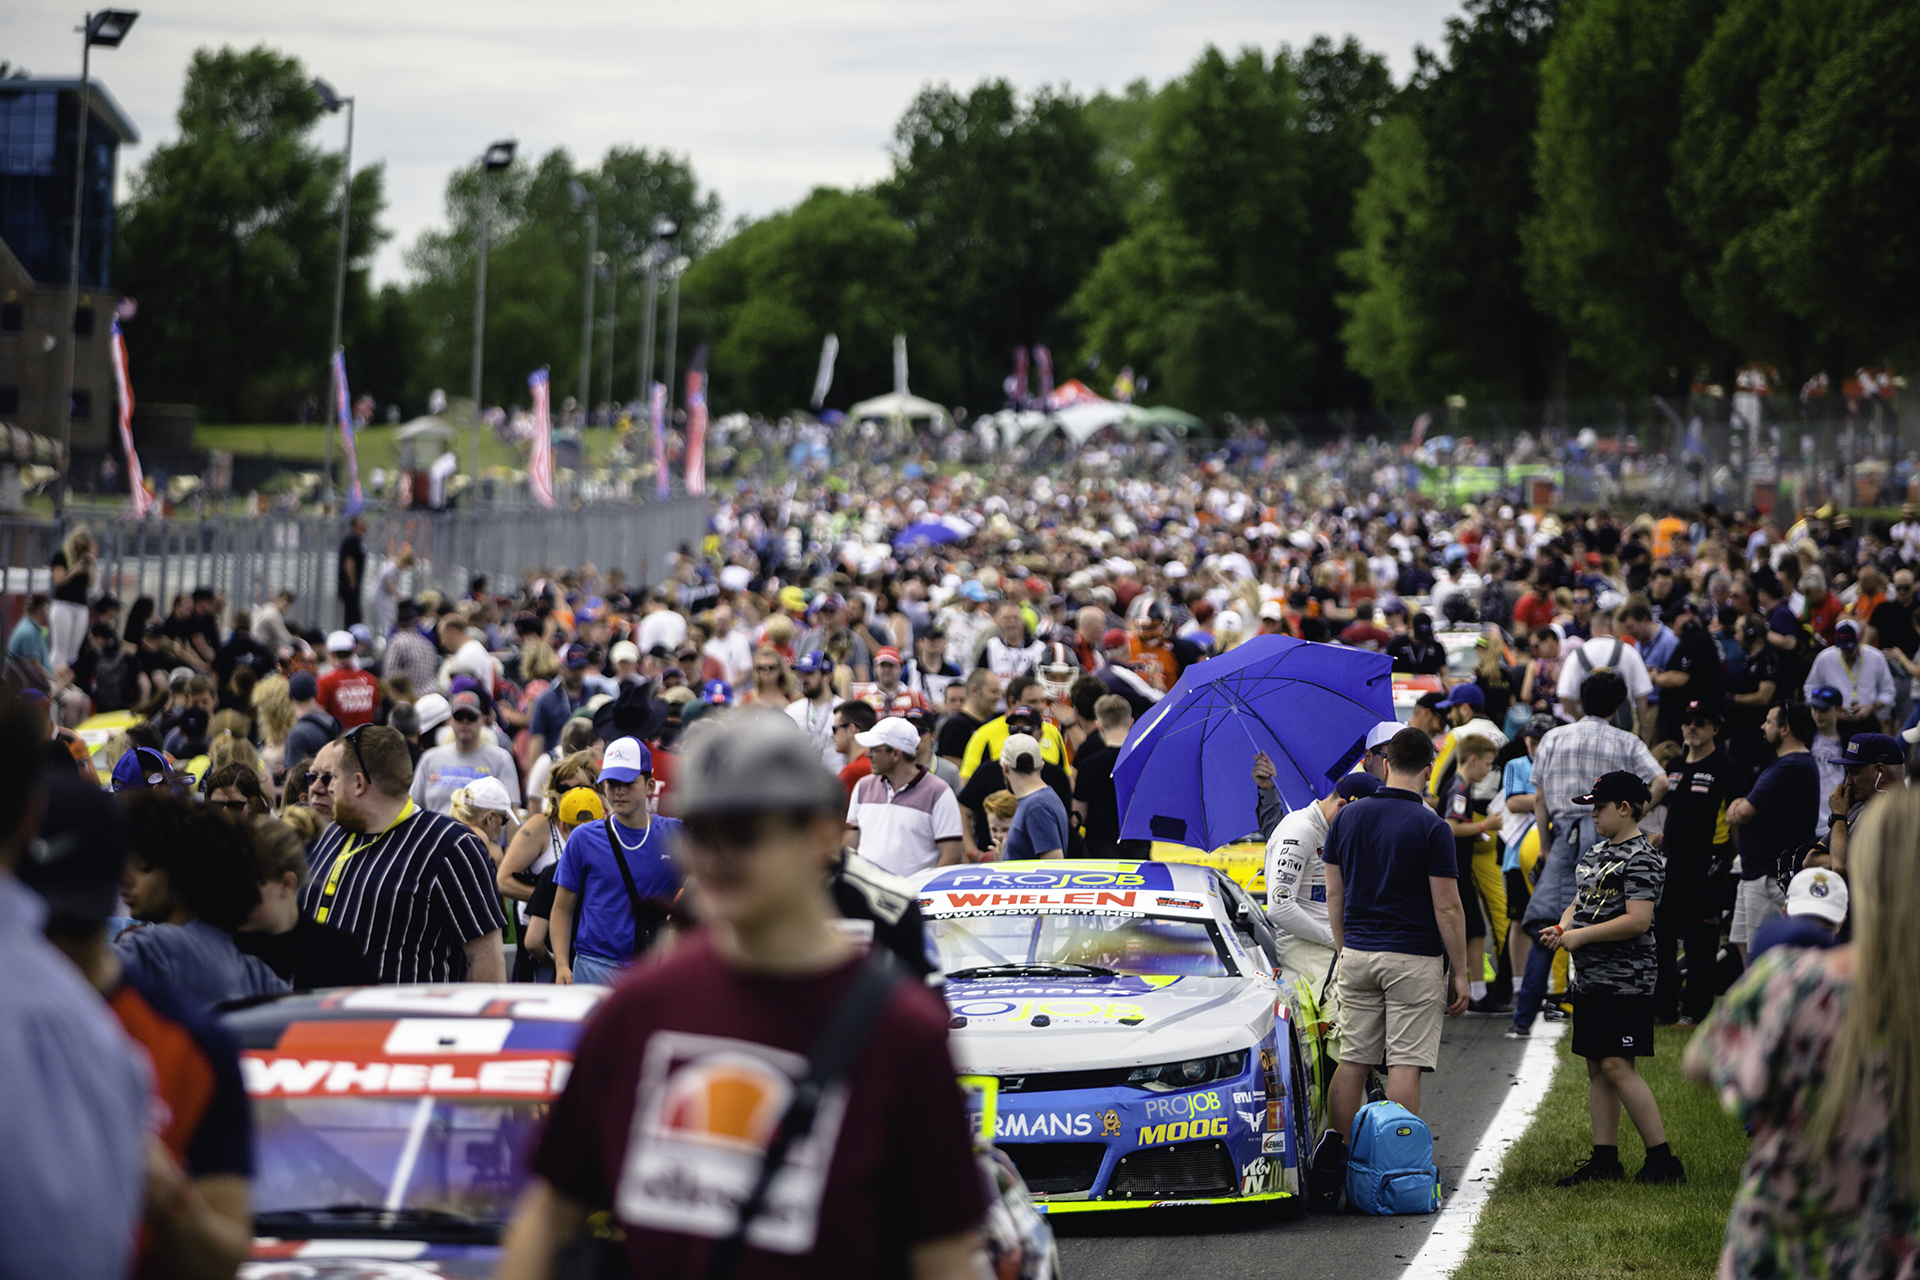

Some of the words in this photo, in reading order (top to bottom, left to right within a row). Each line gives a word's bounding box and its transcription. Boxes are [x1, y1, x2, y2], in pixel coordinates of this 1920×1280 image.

[952, 874, 1146, 888] PROJOB
[946, 892, 1138, 908] WHELEN
[952, 1000, 1146, 1022] OJOB
[240, 1057, 575, 1094] WHELE
[1145, 1091, 1221, 1120] PROJOB
[1138, 1117, 1229, 1146] MOOG
